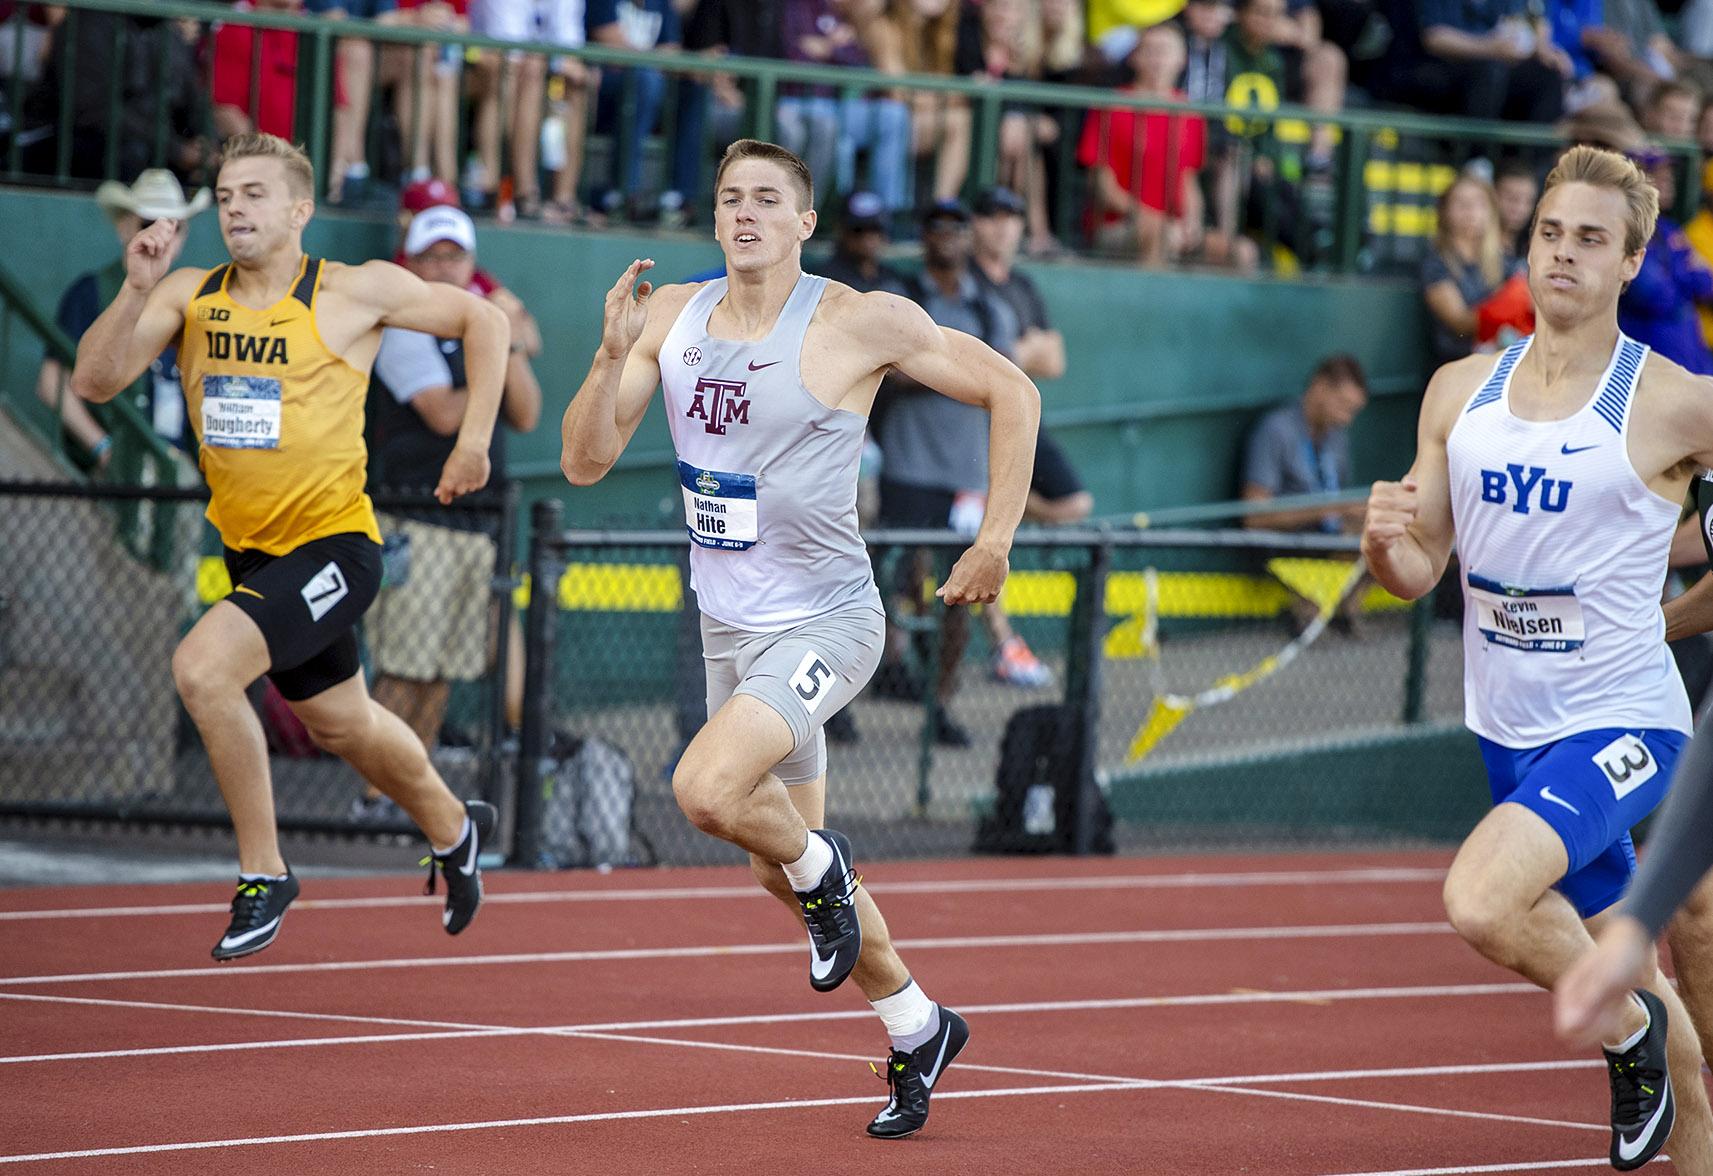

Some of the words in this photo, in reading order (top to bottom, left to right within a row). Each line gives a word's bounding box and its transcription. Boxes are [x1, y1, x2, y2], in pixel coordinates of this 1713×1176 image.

[205, 330, 289, 365] IOWA
[218, 402, 254, 414] William
[205, 415, 273, 436] Dougherty
[1480, 462, 1574, 515] BYU
[693, 496, 727, 514] Nathan
[696, 512, 726, 534] Hite
[310, 572, 342, 604] 7
[1501, 600, 1538, 614] Kevin
[1492, 608, 1563, 636] Nielsen
[795, 658, 831, 701] 5
[1603, 743, 1650, 783] 3
